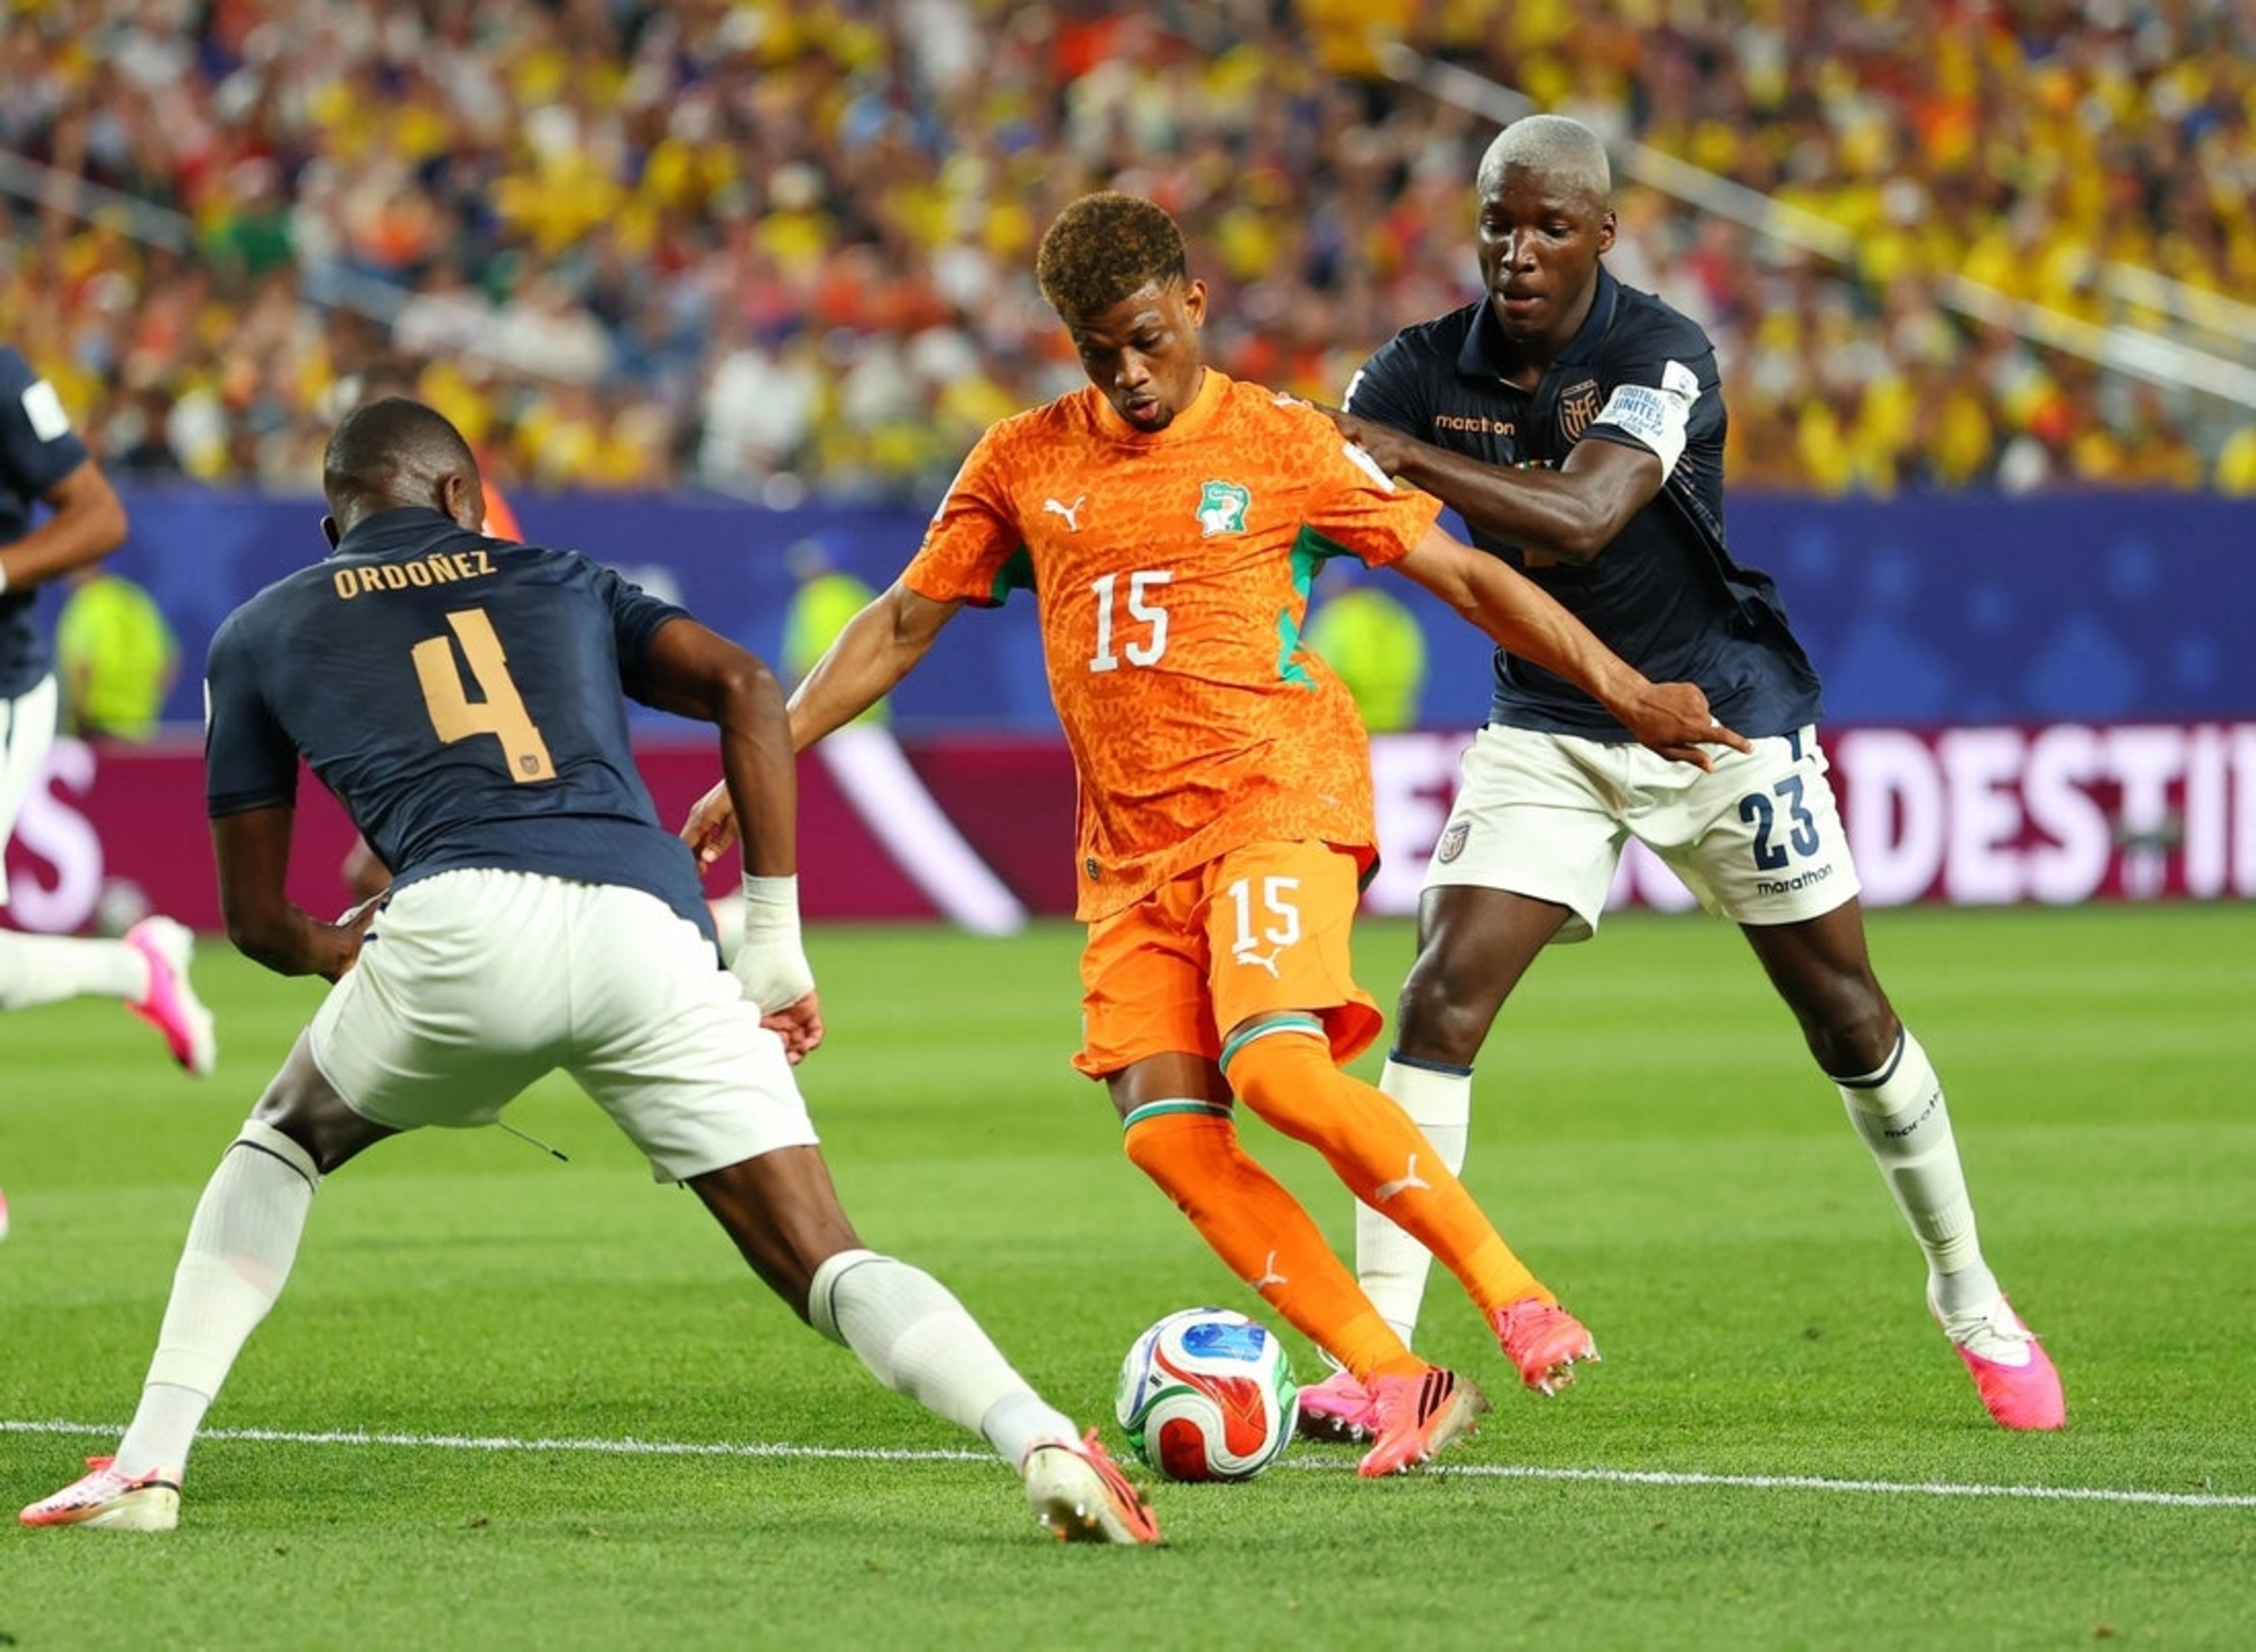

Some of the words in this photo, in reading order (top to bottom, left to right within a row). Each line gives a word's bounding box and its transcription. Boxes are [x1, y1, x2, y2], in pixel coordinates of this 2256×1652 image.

[333, 550, 498, 600] ORDOÑEZ
[1089, 570, 1174, 672] 15
[411, 607, 558, 784] 4
[1738, 774, 1819, 871] 23
[1835, 724, 2256, 907] DESTI
[1227, 876, 1301, 954] 15
[1757, 863, 1834, 895] marathon
